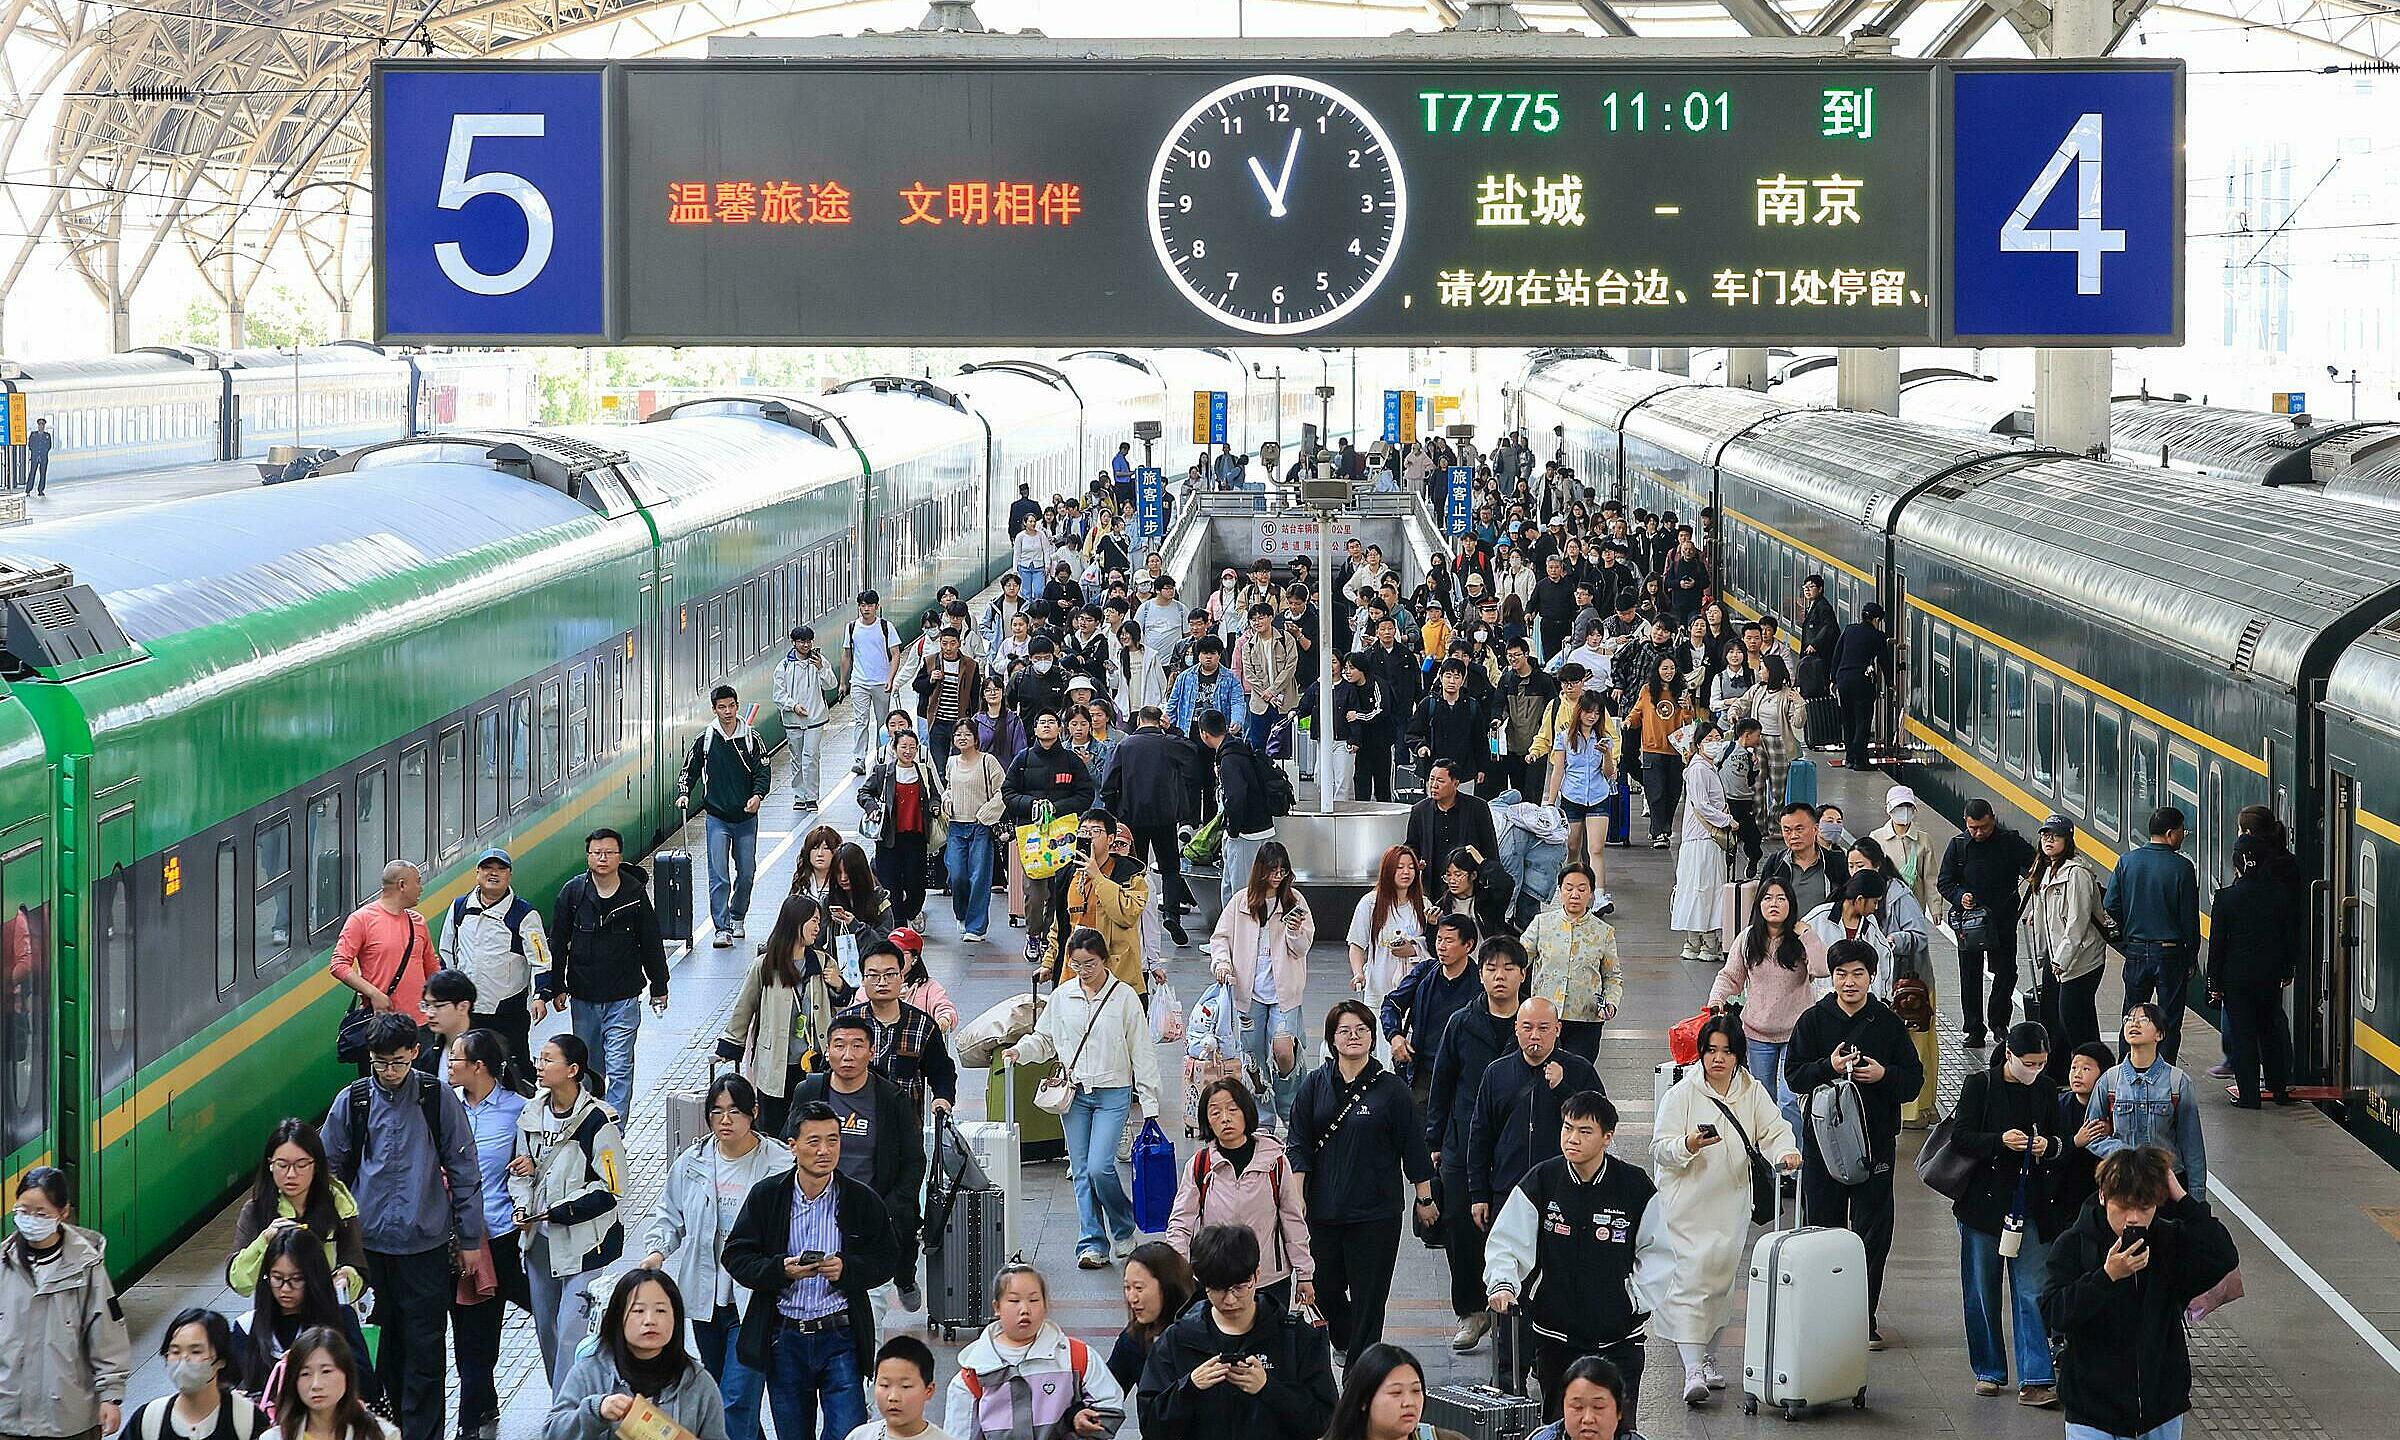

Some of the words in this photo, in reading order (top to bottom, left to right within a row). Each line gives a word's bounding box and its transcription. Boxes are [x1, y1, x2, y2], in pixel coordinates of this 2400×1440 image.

[1266, 103, 1290, 122] 12
[1417, 90, 1562, 134] T7775
[1602, 90, 1730, 134] 11:01
[1821, 86, 1874, 141] 到
[1221, 116, 1242, 134] 11
[1316, 115, 1326, 134] 1
[1187, 150, 1211, 169] 10
[1348, 149, 1360, 168] 2
[433, 114, 553, 295] 5
[668, 180, 852, 226] 温馨旅途
[900, 180, 1082, 226] 文明相伴
[1179, 195, 1192, 213] 9
[1361, 194, 1374, 213] 3
[1474, 172, 1587, 229] 盐城
[1753, 172, 1863, 228] 南京
[2001, 114, 2125, 294] 4
[1192, 239, 1206, 258] 8
[1348, 238, 1361, 256] 4
[1226, 271, 1239, 290] 7
[1316, 271, 1329, 290] 5
[1271, 286, 1285, 304] 6
[1143, 471, 1158, 535] 旅客止步
[1452, 469, 1467, 534] 旅客止步
